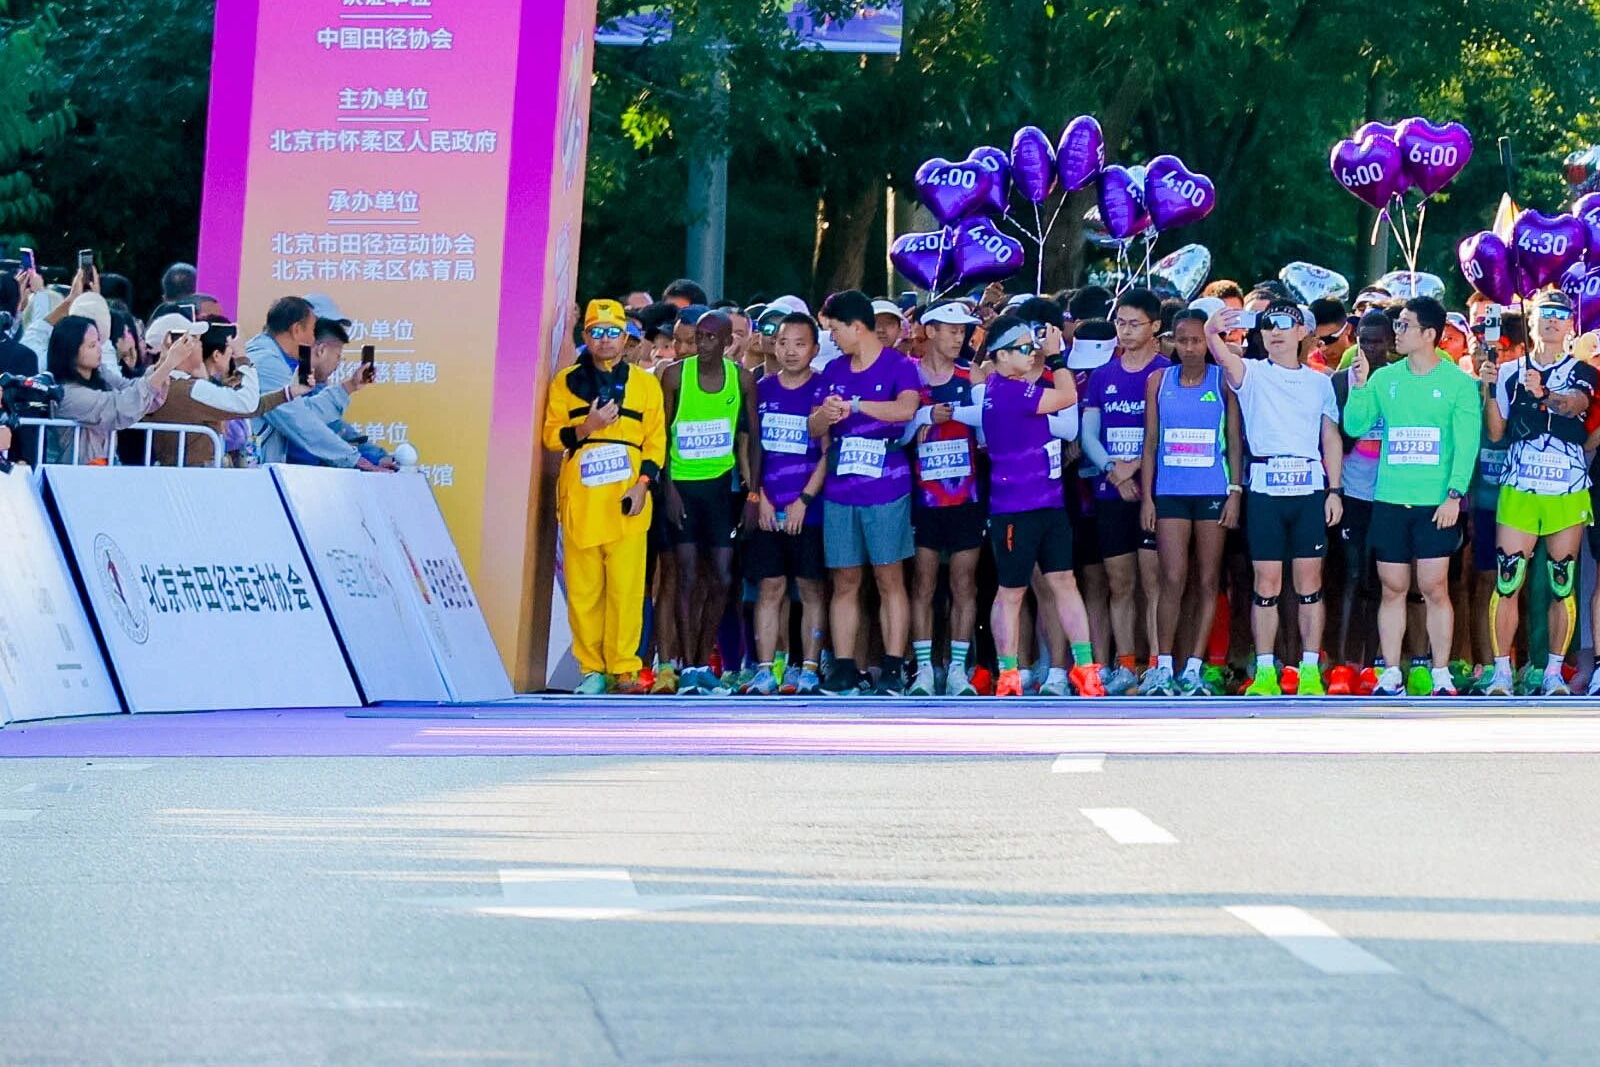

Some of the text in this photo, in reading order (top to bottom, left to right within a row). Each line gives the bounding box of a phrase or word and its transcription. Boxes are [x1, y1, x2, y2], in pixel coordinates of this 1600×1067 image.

[316, 28, 453, 50] 中国田径协会
[337, 88, 428, 111] 主办单位
[270, 130, 497, 153] 北京市怀柔区人民政府
[1409, 145, 1457, 167] 6:00
[927, 167, 976, 189] 4:00
[1341, 162, 1384, 187] 6:00
[1161, 170, 1206, 207] 4:00
[328, 190, 419, 213] 承办单位
[271, 233, 476, 256] 北京市田径运动协会
[905, 234, 953, 251] 4:00
[967, 225, 1013, 263] 4:00
[1517, 229, 1567, 256] 4:30
[271, 259, 476, 282] 北京市怀柔区体育局
[348, 319, 414, 341] 办单位
[686, 435, 725, 447] A0023
[767, 428, 803, 440] A3240
[843, 451, 879, 464] A1713
[1395, 441, 1433, 452] A3289
[587, 458, 625, 475] A0180
[927, 453, 964, 467] A3425
[1272, 471, 1308, 484] A2677
[1525, 465, 1563, 479] A0150
[140, 563, 313, 613] 北京市田径运动协会
